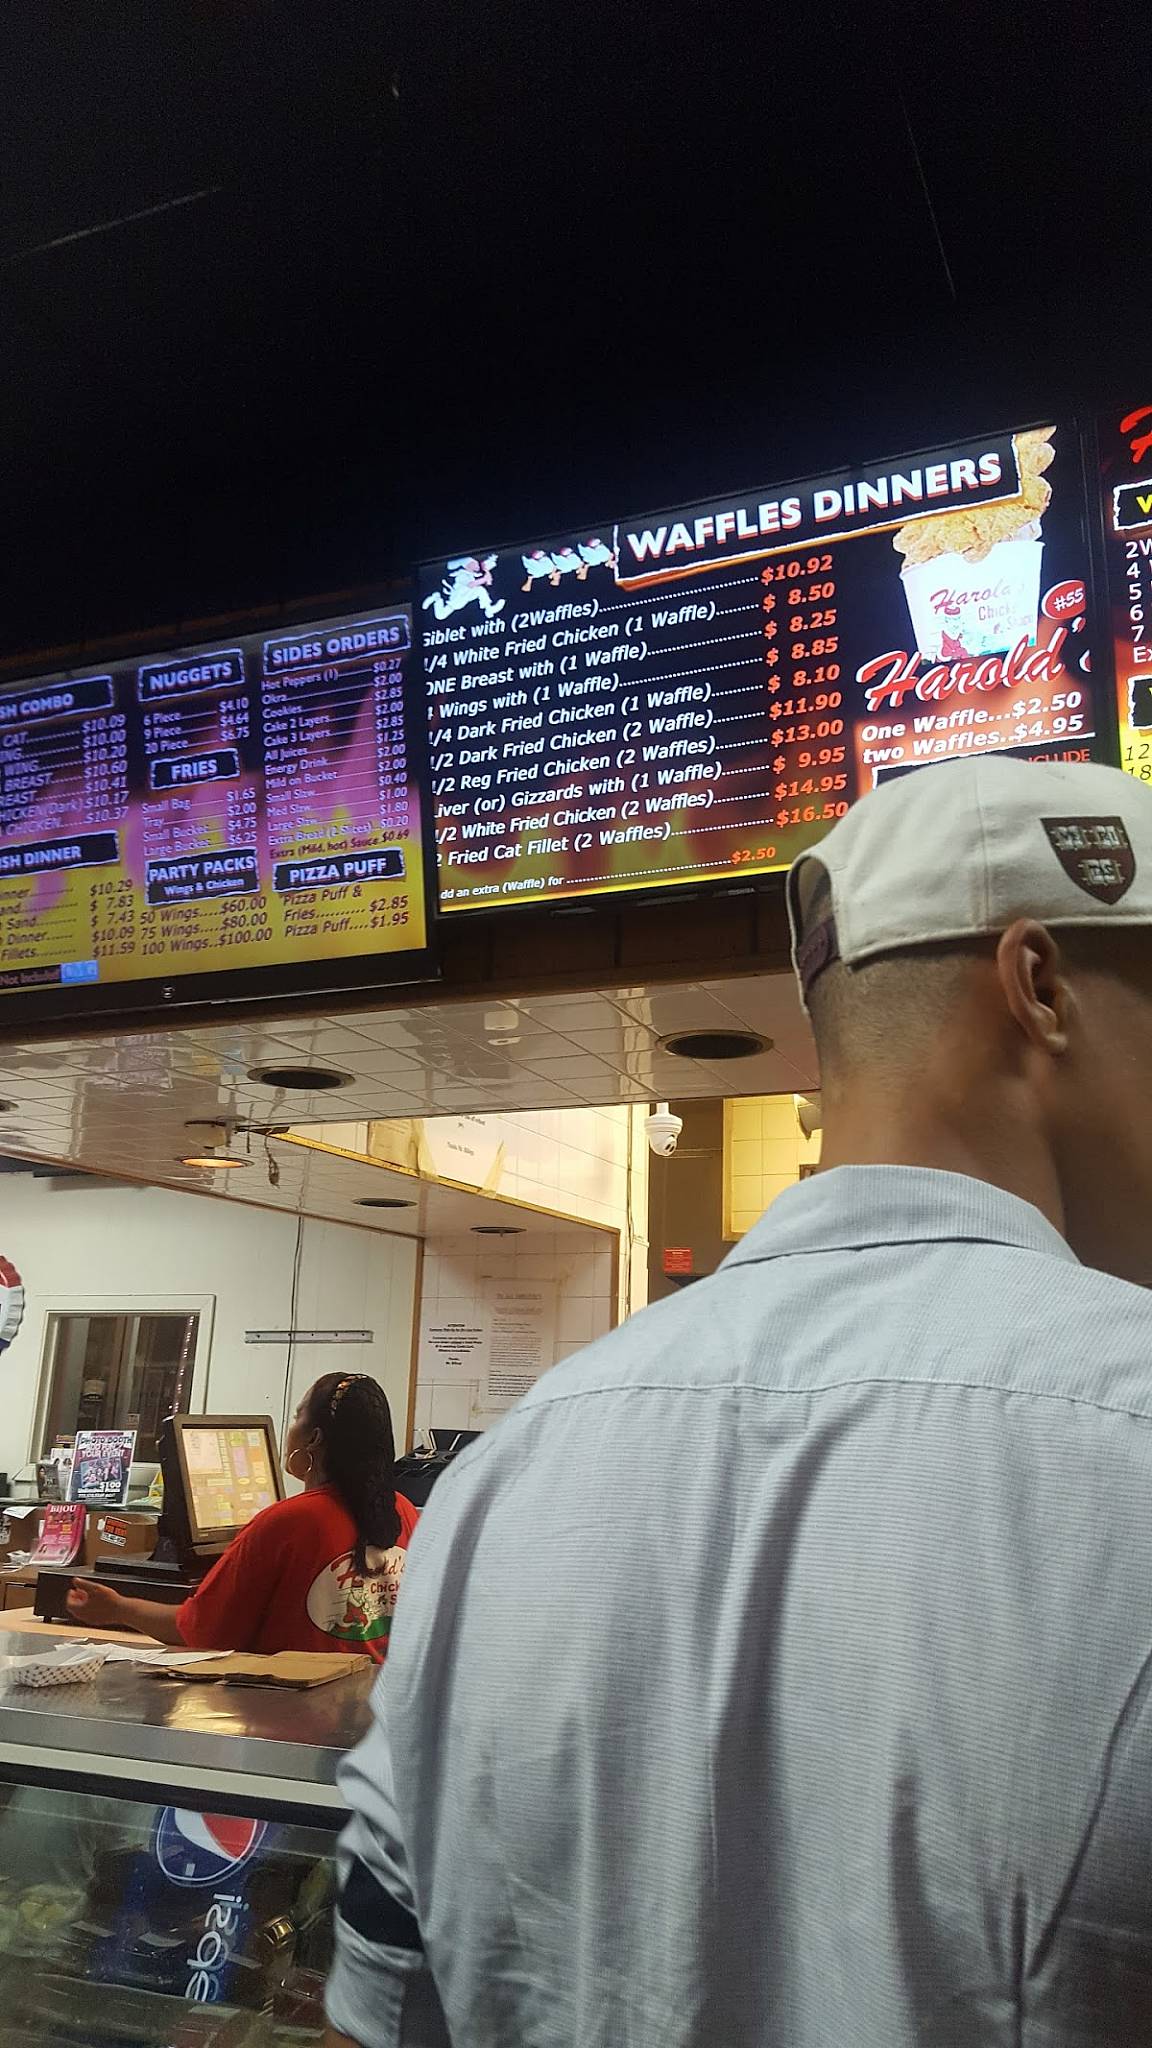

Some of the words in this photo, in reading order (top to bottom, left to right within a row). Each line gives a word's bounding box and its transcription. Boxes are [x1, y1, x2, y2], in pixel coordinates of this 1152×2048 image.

[628, 497, 800, 562] WAFFLES
[813, 453, 1002, 522] DINNERS
[1127, 562, 1140, 578] 4
[472, 618, 505, 637] with
[511, 599, 598, 633] (2Waffles)
[761, 554, 832, 585] $10.92
[1053, 588, 1084, 611] #55
[1129, 583, 1142, 600] 5
[454, 646, 500, 666] White
[504, 635, 546, 656] Fried
[552, 623, 619, 647] Chicken
[626, 616, 644, 636] (1
[652, 601, 716, 628] Waffle)
[762, 593, 776, 612] $
[787, 582, 834, 604] 8.50
[1130, 604, 1144, 620] 6
[272, 642, 322, 664] SIDES
[326, 627, 400, 653] ORDERS
[1131, 625, 1144, 642] 7
[461, 669, 514, 690] Breast
[519, 661, 554, 679] with
[560, 656, 578, 675] (1
[585, 642, 648, 667] Waffle)
[764, 620, 778, 640] $
[789, 610, 837, 632] 8.25
[150, 662, 232, 690] NUGGETS
[440, 699, 487, 720] Wings
[493, 691, 527, 709] with
[533, 686, 550, 705] (1
[558, 673, 620, 698] Waffle)
[766, 648, 779, 666] $
[791, 636, 838, 659] 8.85
[20, 693, 74, 714] COMBO
[458, 722, 496, 740] Dark
[501, 713, 542, 734] Fried
[549, 702, 615, 725] Chicken
[621, 696, 639, 716] (1
[647, 682, 712, 708] Waffle)
[768, 674, 780, 693] $
[792, 664, 840, 687] 8.10
[144, 715, 151, 726] 6
[459, 746, 498, 765] Dark
[503, 739, 544, 758] Fried
[550, 728, 616, 750] Chicken
[623, 722, 642, 741] (2
[649, 710, 713, 734] Waffle)
[769, 692, 842, 720] $11.90
[862, 723, 906, 742] One
[1011, 692, 1082, 718] $2.50
[863, 747, 904, 764] two
[1014, 715, 1084, 742] $4.95
[461, 774, 491, 790] Reg
[497, 766, 538, 784] Fried
[544, 754, 610, 777] Chicken
[617, 749, 635, 768] (2
[642, 736, 716, 762] Waffles)
[771, 719, 844, 747] $13.00
[172, 760, 218, 780] FRIES
[474, 794, 505, 815] (or)
[511, 785, 582, 806] Gizzards
[588, 778, 625, 795] with
[631, 774, 649, 792] (1
[658, 762, 722, 785] Waffle)
[773, 755, 786, 774] $
[798, 746, 845, 768] 9.95
[462, 821, 506, 840] White
[510, 814, 549, 832] Fried
[554, 806, 616, 826] Chicken
[621, 801, 639, 820] (2
[646, 790, 713, 812] Waffles)
[775, 774, 848, 800] $14.95
[448, 848, 488, 866] Fried
[494, 843, 522, 860] Cat
[528, 837, 568, 855] Fillet
[574, 832, 592, 852] (2
[600, 822, 671, 846] Waffles)
[776, 802, 848, 828] $16.50
[24, 846, 82, 865] DINNER
[150, 863, 199, 882] PARTY
[204, 856, 256, 875] PACKS
[290, 864, 338, 883] PIZZA
[344, 858, 387, 876] PUFF
[456, 888, 470, 898] an
[472, 884, 500, 896] extra
[503, 878, 545, 893] (Waffle)
[548, 876, 564, 886] for
[731, 847, 776, 864] $2.50
[90, 880, 133, 896] $10.29
[164, 884, 194, 896] Wings
[206, 878, 244, 890] Chicken
[283, 892, 316, 906] Pizza
[322, 887, 349, 901] Puff
[352, 885, 362, 898] &
[140, 912, 156, 925] 50
[160, 908, 200, 922] Wings
[222, 896, 267, 914] $60.00
[284, 909, 315, 922] Fries
[369, 895, 409, 912] $2.85
[92, 926, 134, 943] $10.09
[141, 927, 157, 940] 75
[162, 924, 200, 938] Wings
[222, 912, 268, 930] $80.00
[285, 924, 317, 938] Pizza
[322, 918, 350, 932] Puff
[370, 912, 410, 928] $1.95
[142, 943, 165, 956] 100
[170, 938, 208, 952] Wings
[219, 928, 272, 946] $100.00
